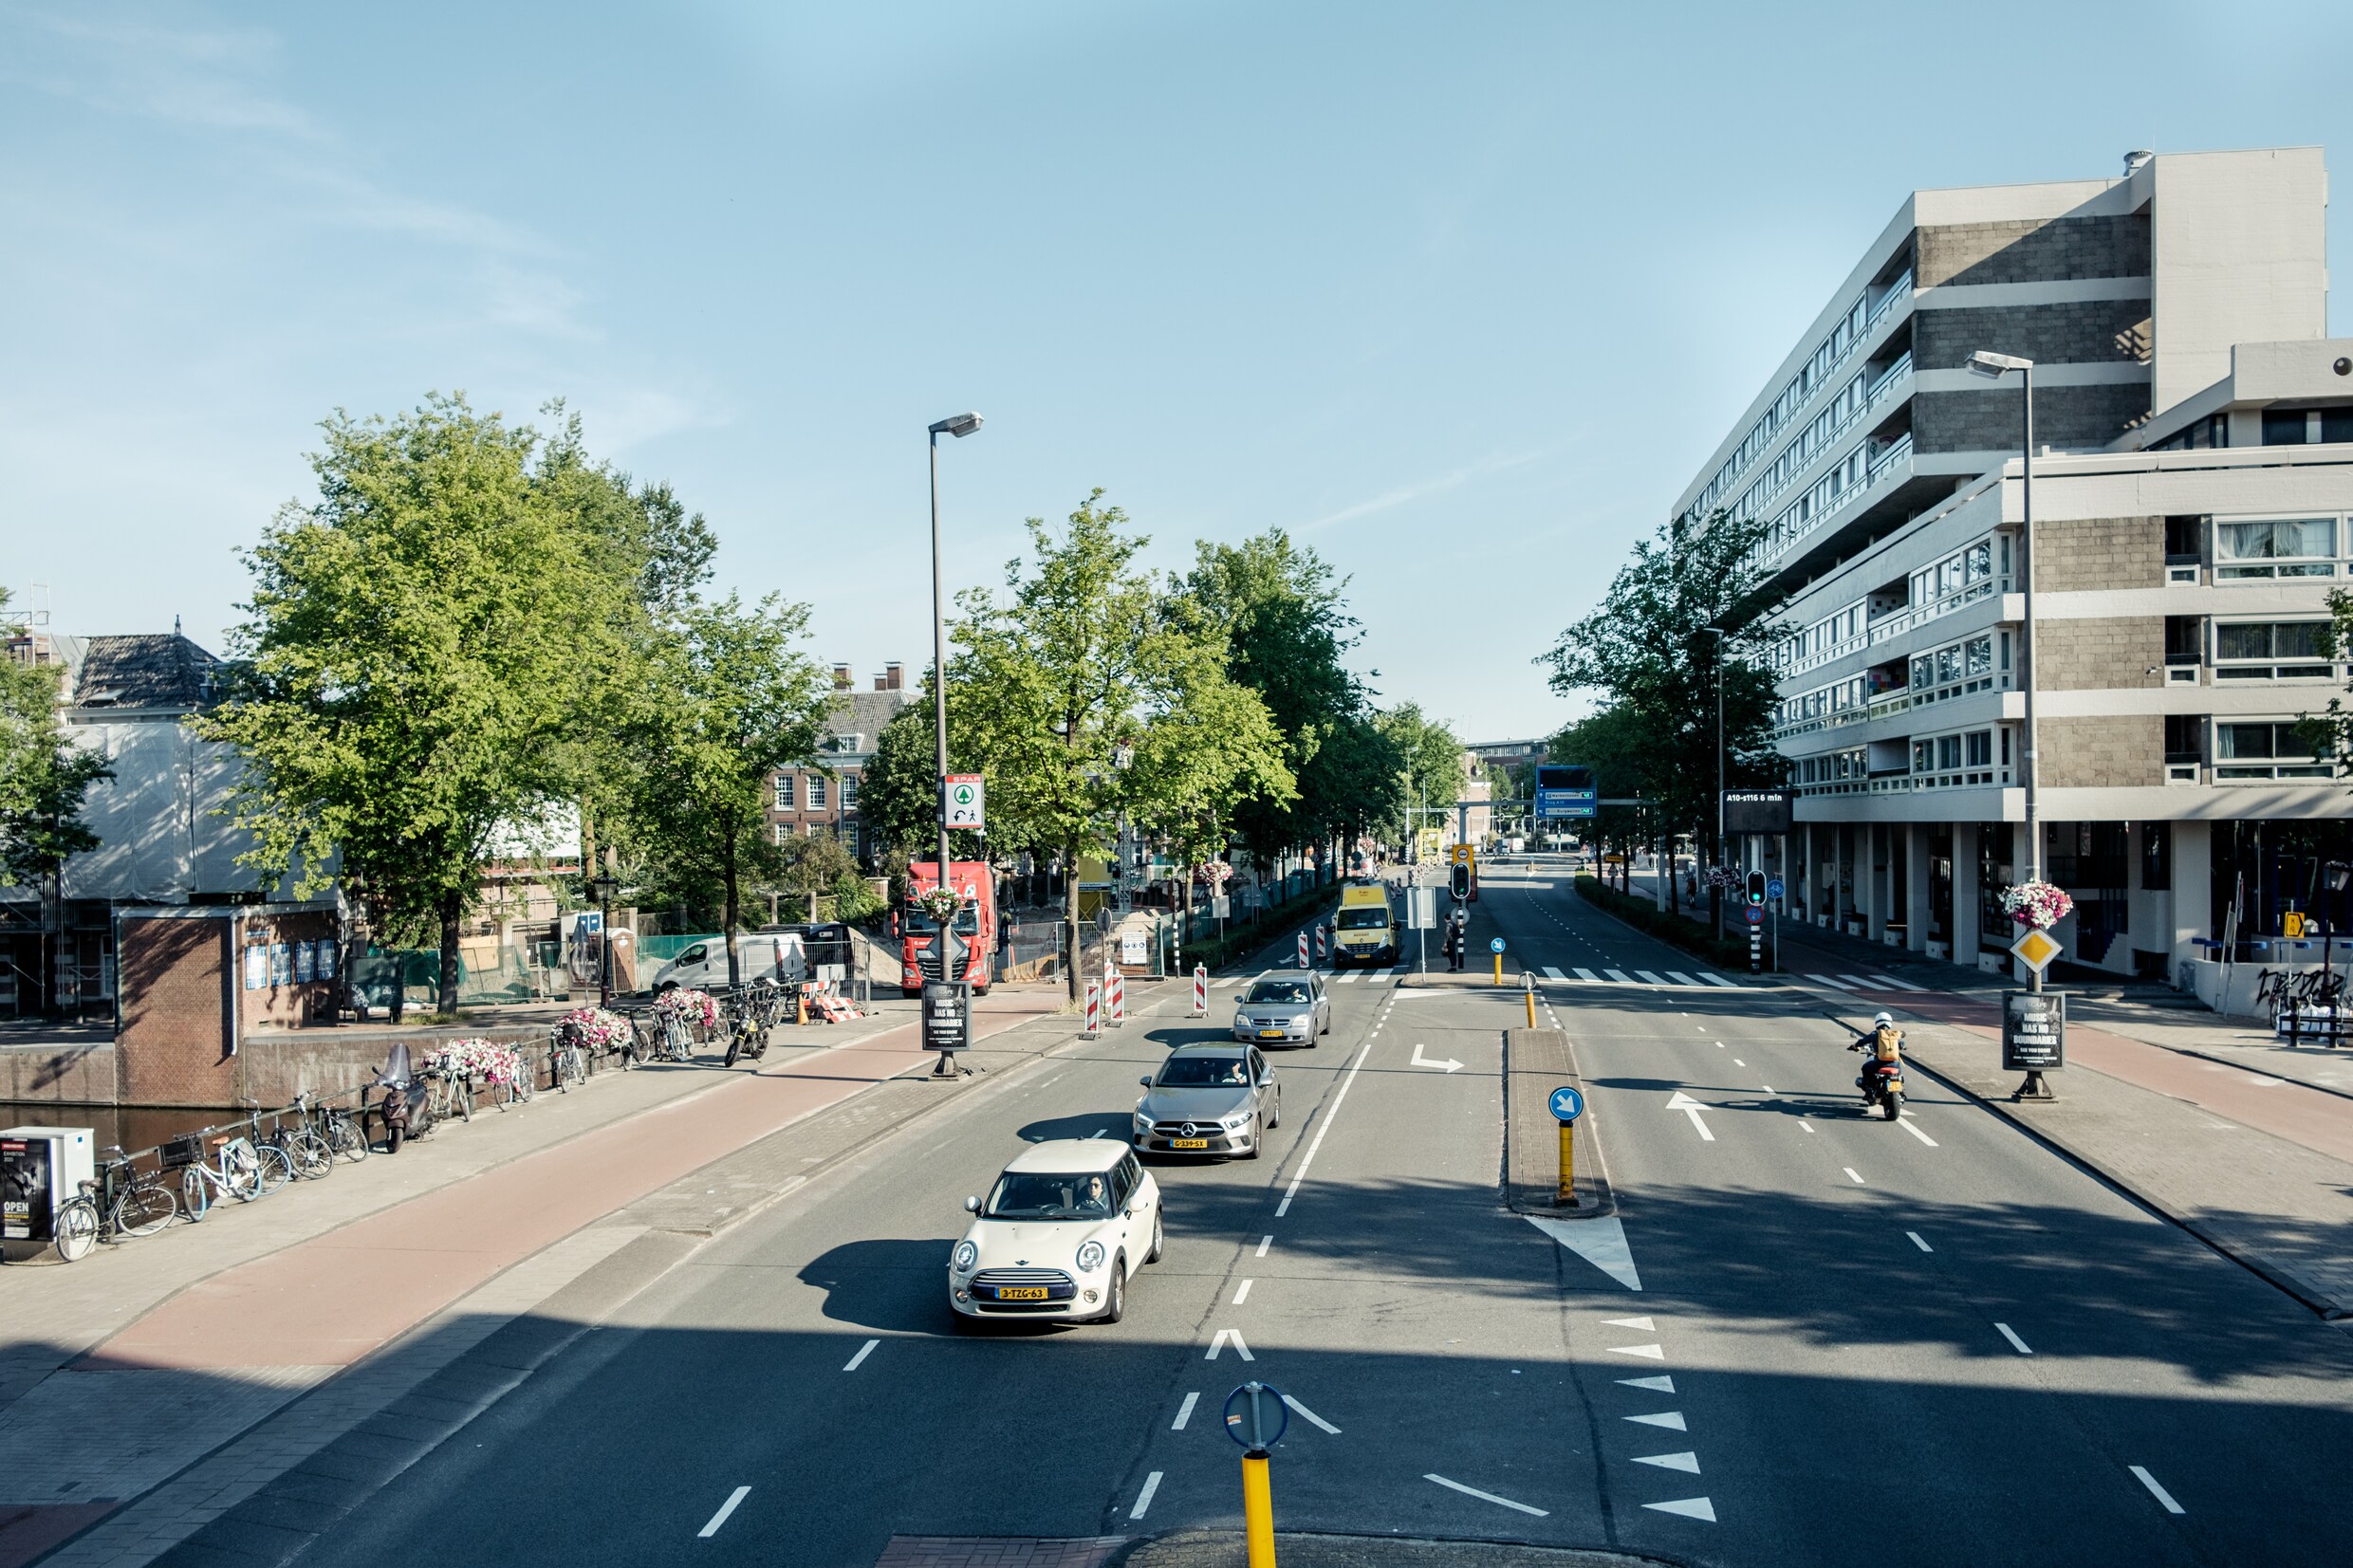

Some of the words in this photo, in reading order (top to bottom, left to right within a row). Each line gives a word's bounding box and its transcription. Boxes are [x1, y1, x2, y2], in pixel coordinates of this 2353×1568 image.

[1767, 793, 1783, 802] min
[2024, 1012, 2047, 1023] MUSIC
[2022, 1024, 2037, 1033] HAS
[2038, 1024, 2048, 1033] NO
[2013, 1035, 2057, 1045] BOUNDARIES
[4, 1202, 28, 1212] OPEN
